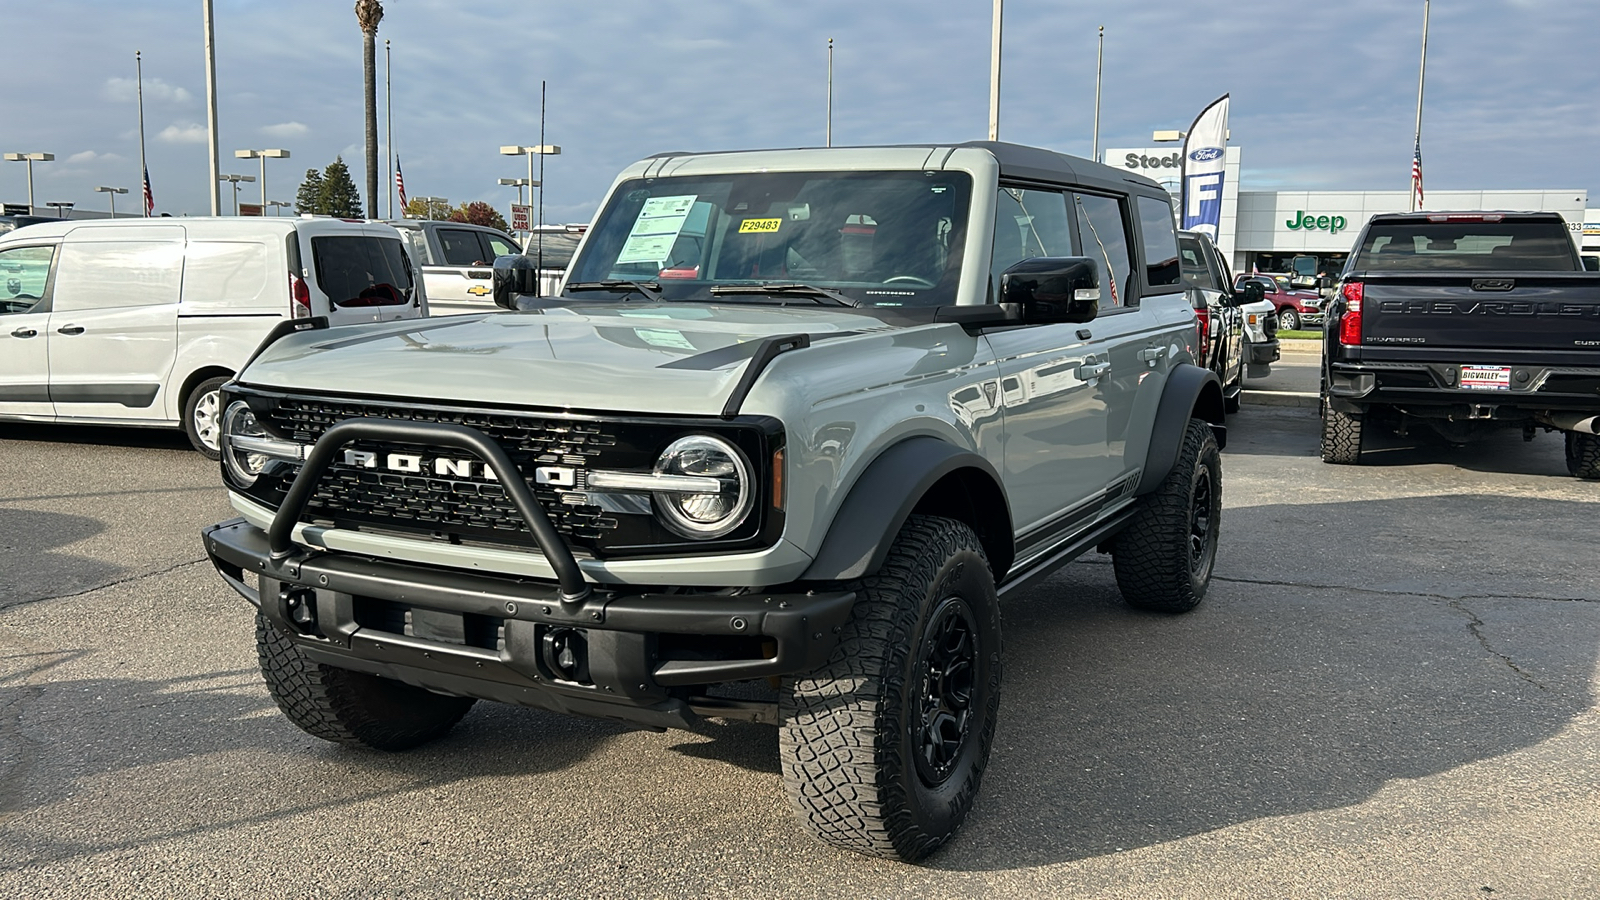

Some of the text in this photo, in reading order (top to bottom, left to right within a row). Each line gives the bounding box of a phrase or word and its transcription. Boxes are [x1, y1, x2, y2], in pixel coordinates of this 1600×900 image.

[1195, 149, 1218, 160] Ford
[513, 221, 528, 230] CARS
[741, 220, 779, 231] F29483
[1286, 210, 1347, 233] Jeep
[1380, 301, 1600, 316] CHEVROLET
